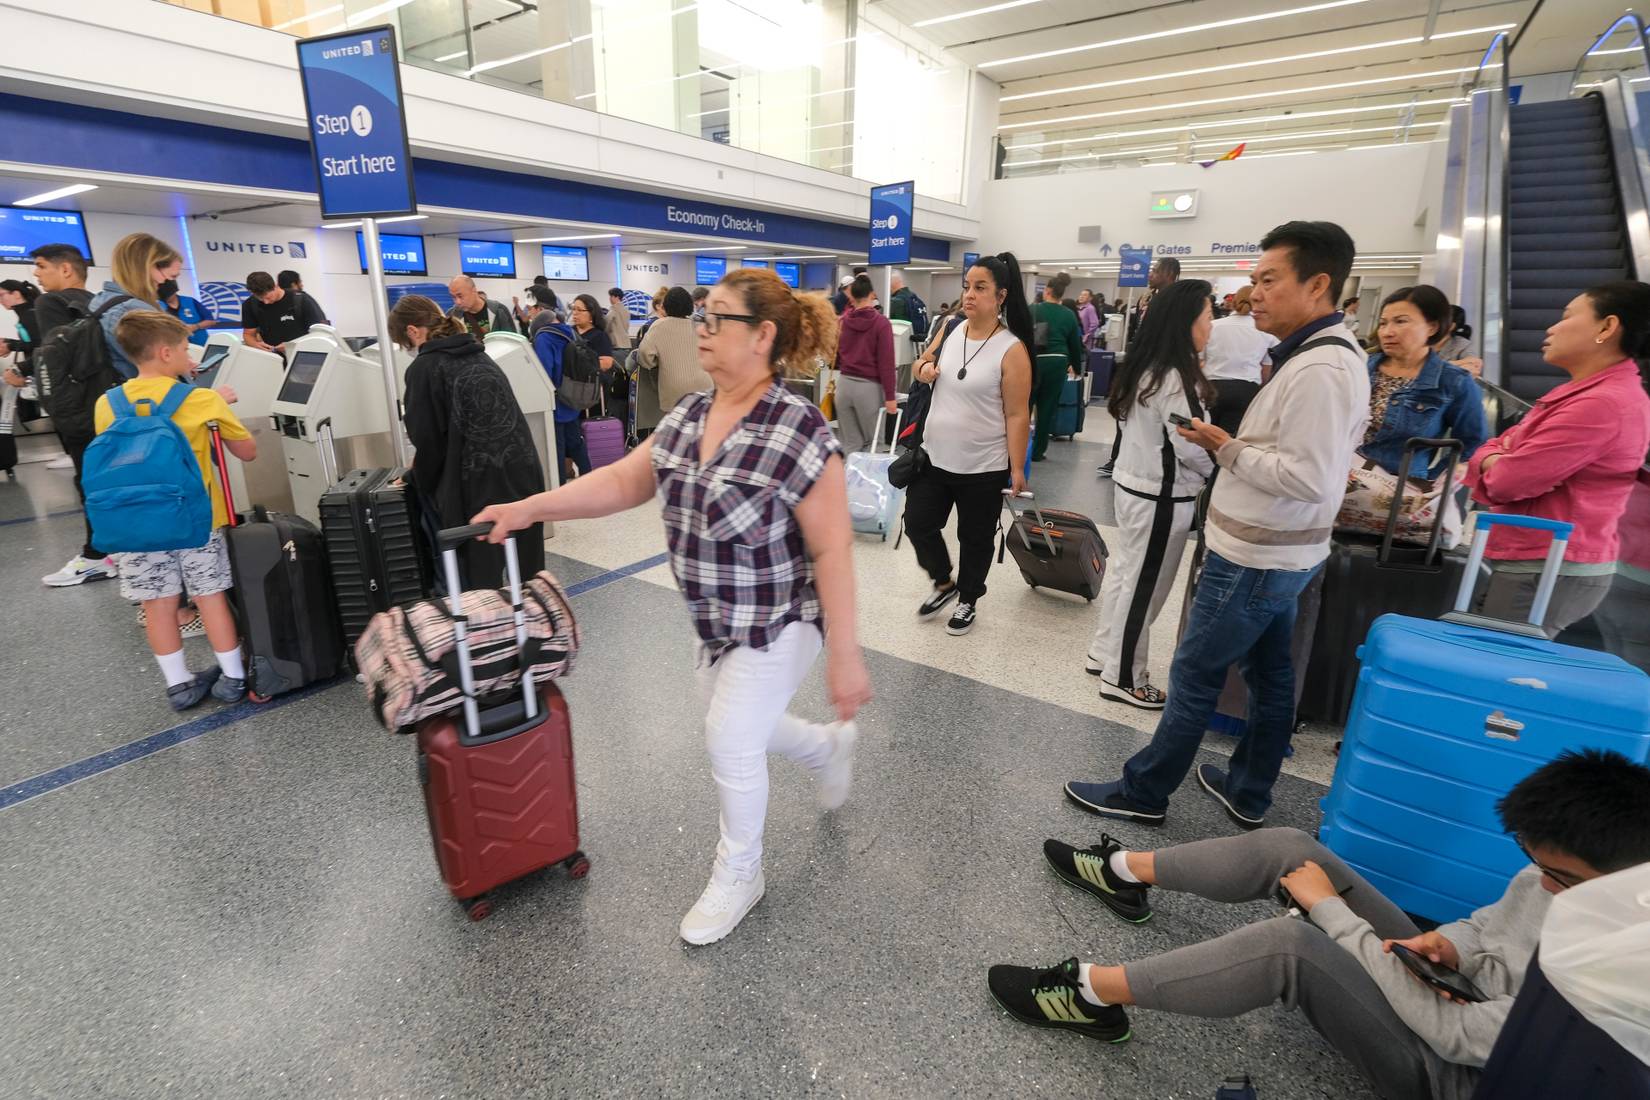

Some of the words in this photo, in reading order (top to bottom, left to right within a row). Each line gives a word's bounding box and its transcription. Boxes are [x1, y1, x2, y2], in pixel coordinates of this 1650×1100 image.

[322, 45, 361, 59] UNITED
[316, 114, 350, 135] Step
[322, 155, 359, 176] Start
[360, 153, 396, 174] here
[667, 205, 720, 231] Economy
[721, 214, 765, 233] Check-In
[872, 218, 888, 229] Step
[206, 241, 284, 255] UNITED
[871, 238, 888, 248] Start
[888, 236, 905, 246] here
[1210, 242, 1262, 253] Premier
[1156, 244, 1192, 255] Gates
[466, 257, 499, 265] UNITED
[626, 264, 660, 272] UNITED
